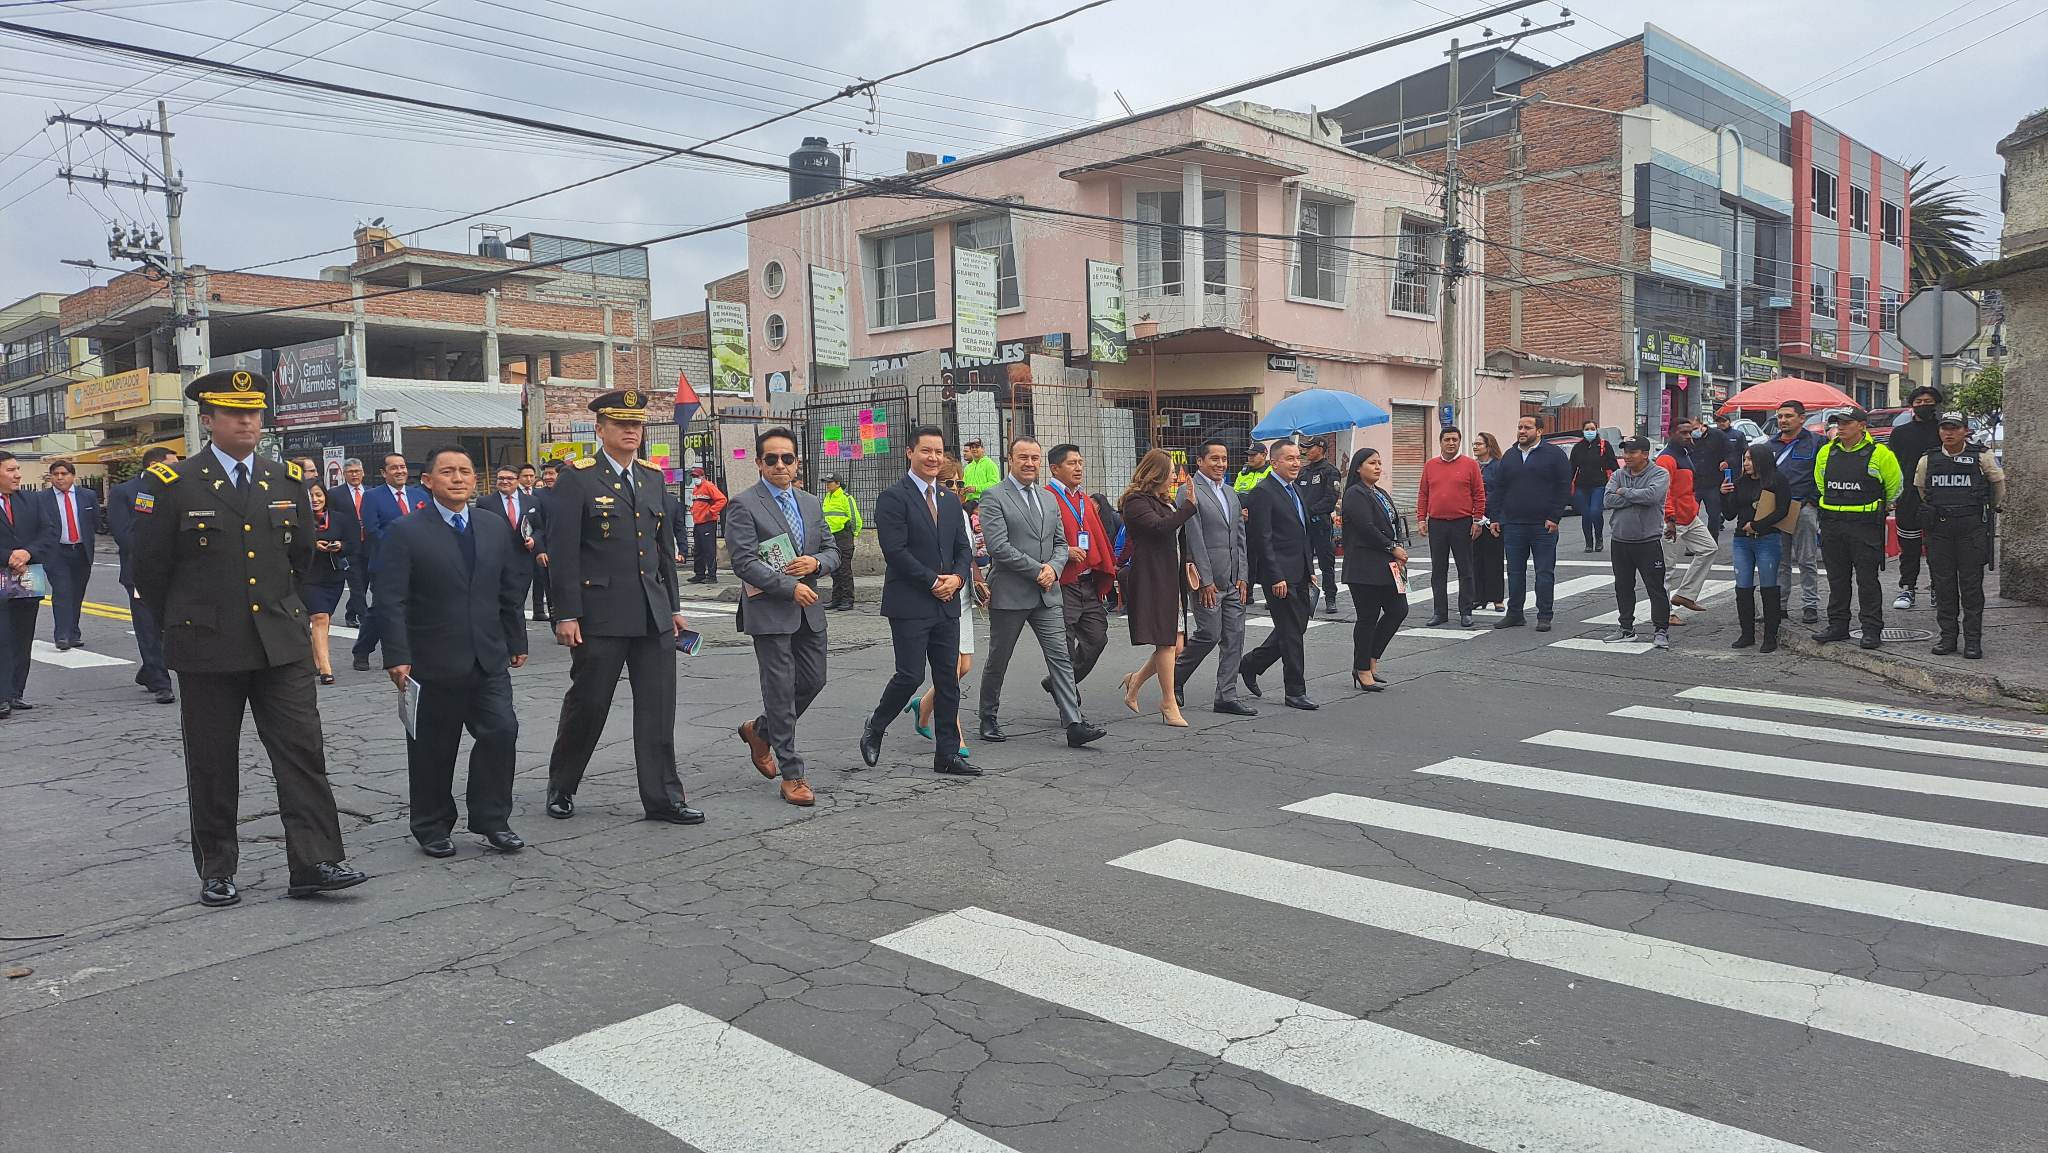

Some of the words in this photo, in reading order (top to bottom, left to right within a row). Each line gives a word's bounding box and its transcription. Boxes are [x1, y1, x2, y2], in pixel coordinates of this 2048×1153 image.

[1093, 281, 1122, 291] IMPORTADO
[713, 317, 744, 327] IMPORTADO
[960, 326, 990, 336] SELLADOR
[962, 337, 978, 345] CERA
[978, 339, 993, 347] PARA
[964, 344, 992, 353] MESONES
[940, 342, 1025, 370] ARMLES
[302, 360, 323, 378] Grani
[300, 375, 336, 394] Mármoles
[1827, 480, 1862, 490] POLICIA
[1931, 474, 1972, 487] POLICIA
